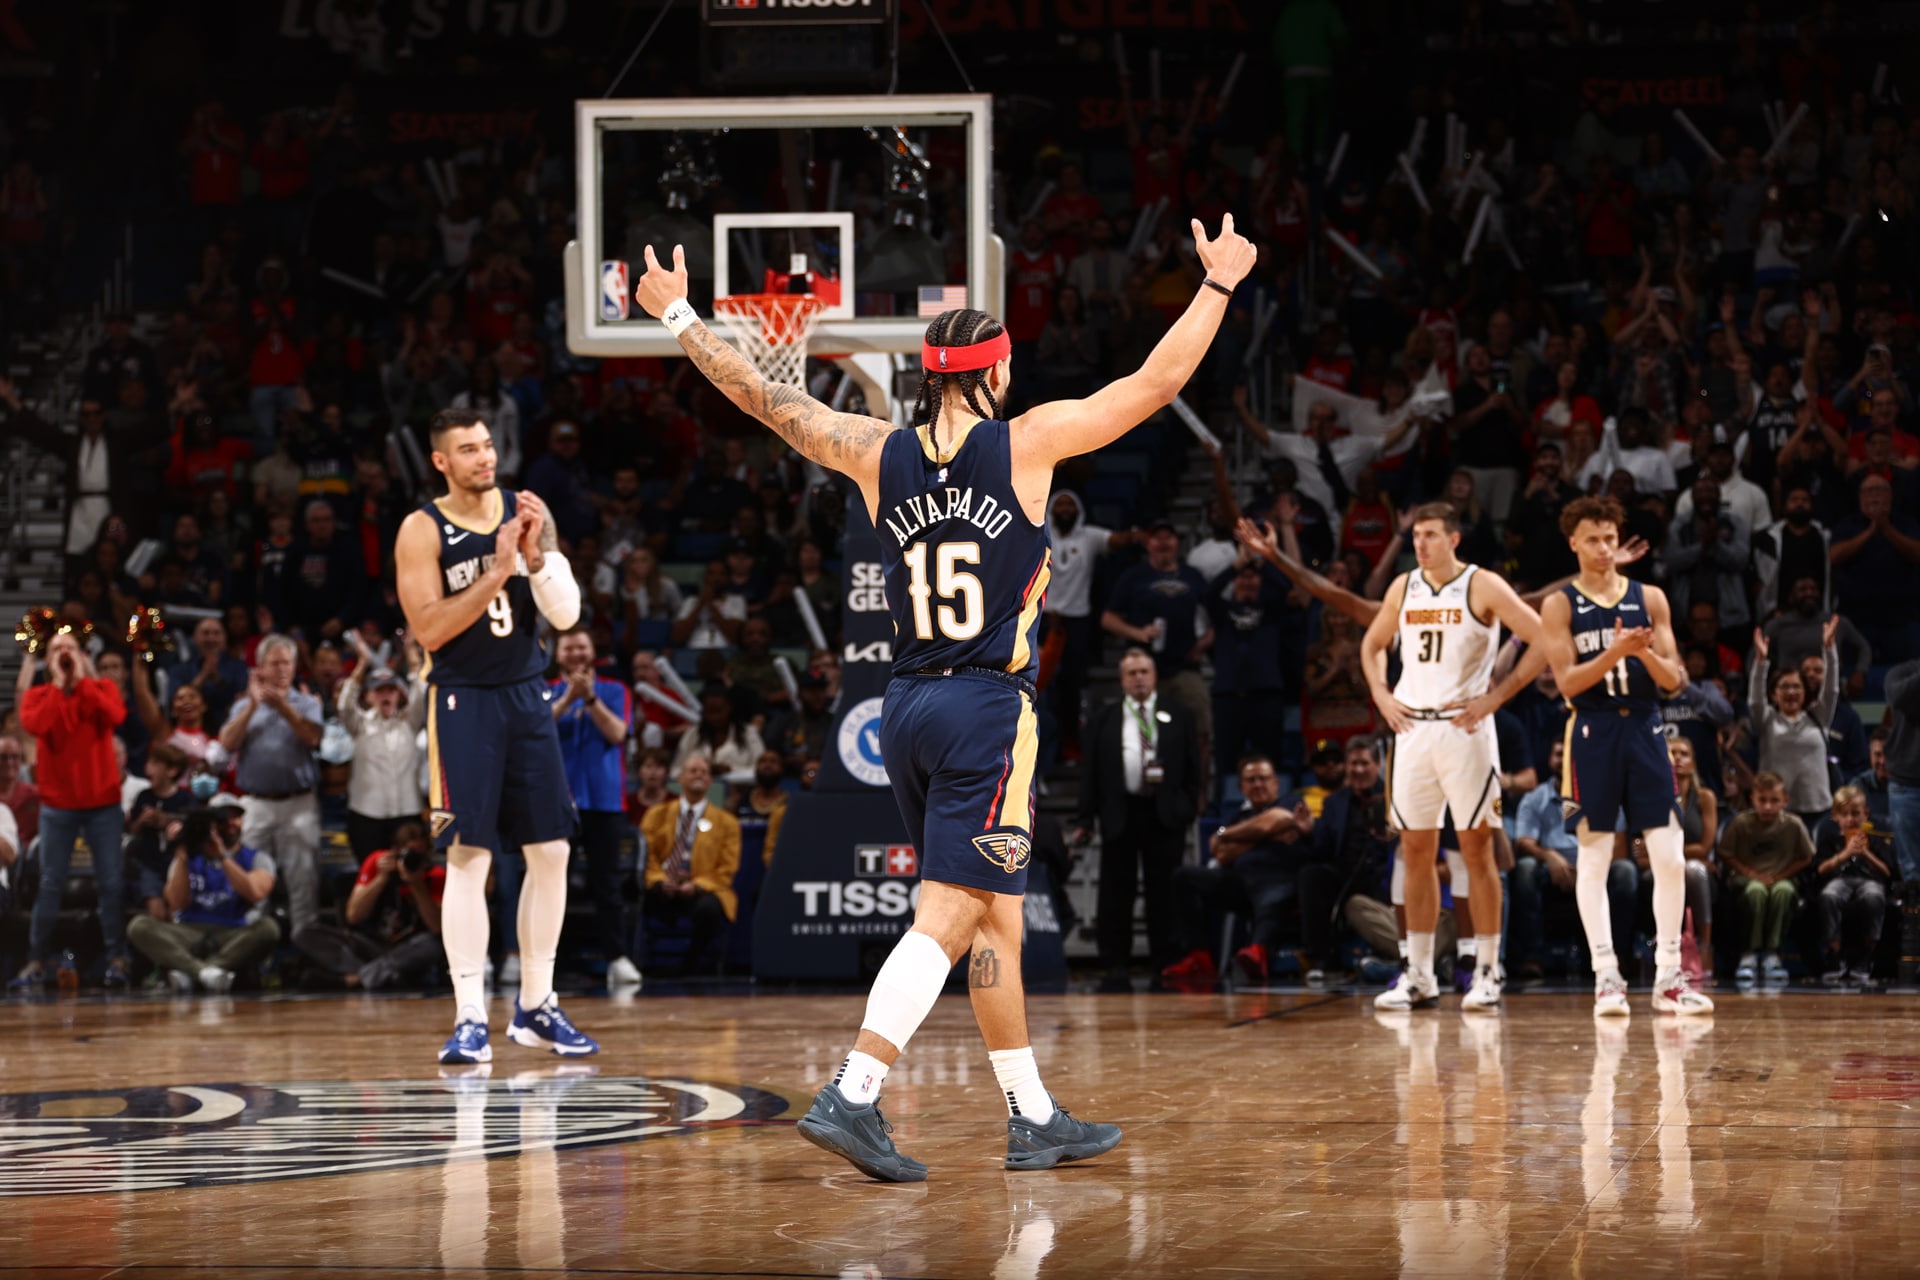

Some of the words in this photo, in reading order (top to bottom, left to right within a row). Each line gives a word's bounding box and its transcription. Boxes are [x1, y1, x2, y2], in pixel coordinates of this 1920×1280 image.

[885, 487, 1013, 548] ALVARADO
[850, 562, 887, 588] SE
[903, 541, 985, 641] 15
[487, 588, 514, 638] 9
[1405, 608, 1462, 625] NUGGETS
[1418, 630, 1443, 663] 31
[791, 922, 834, 936] SWISS
[838, 922, 899, 936] WATCHES
